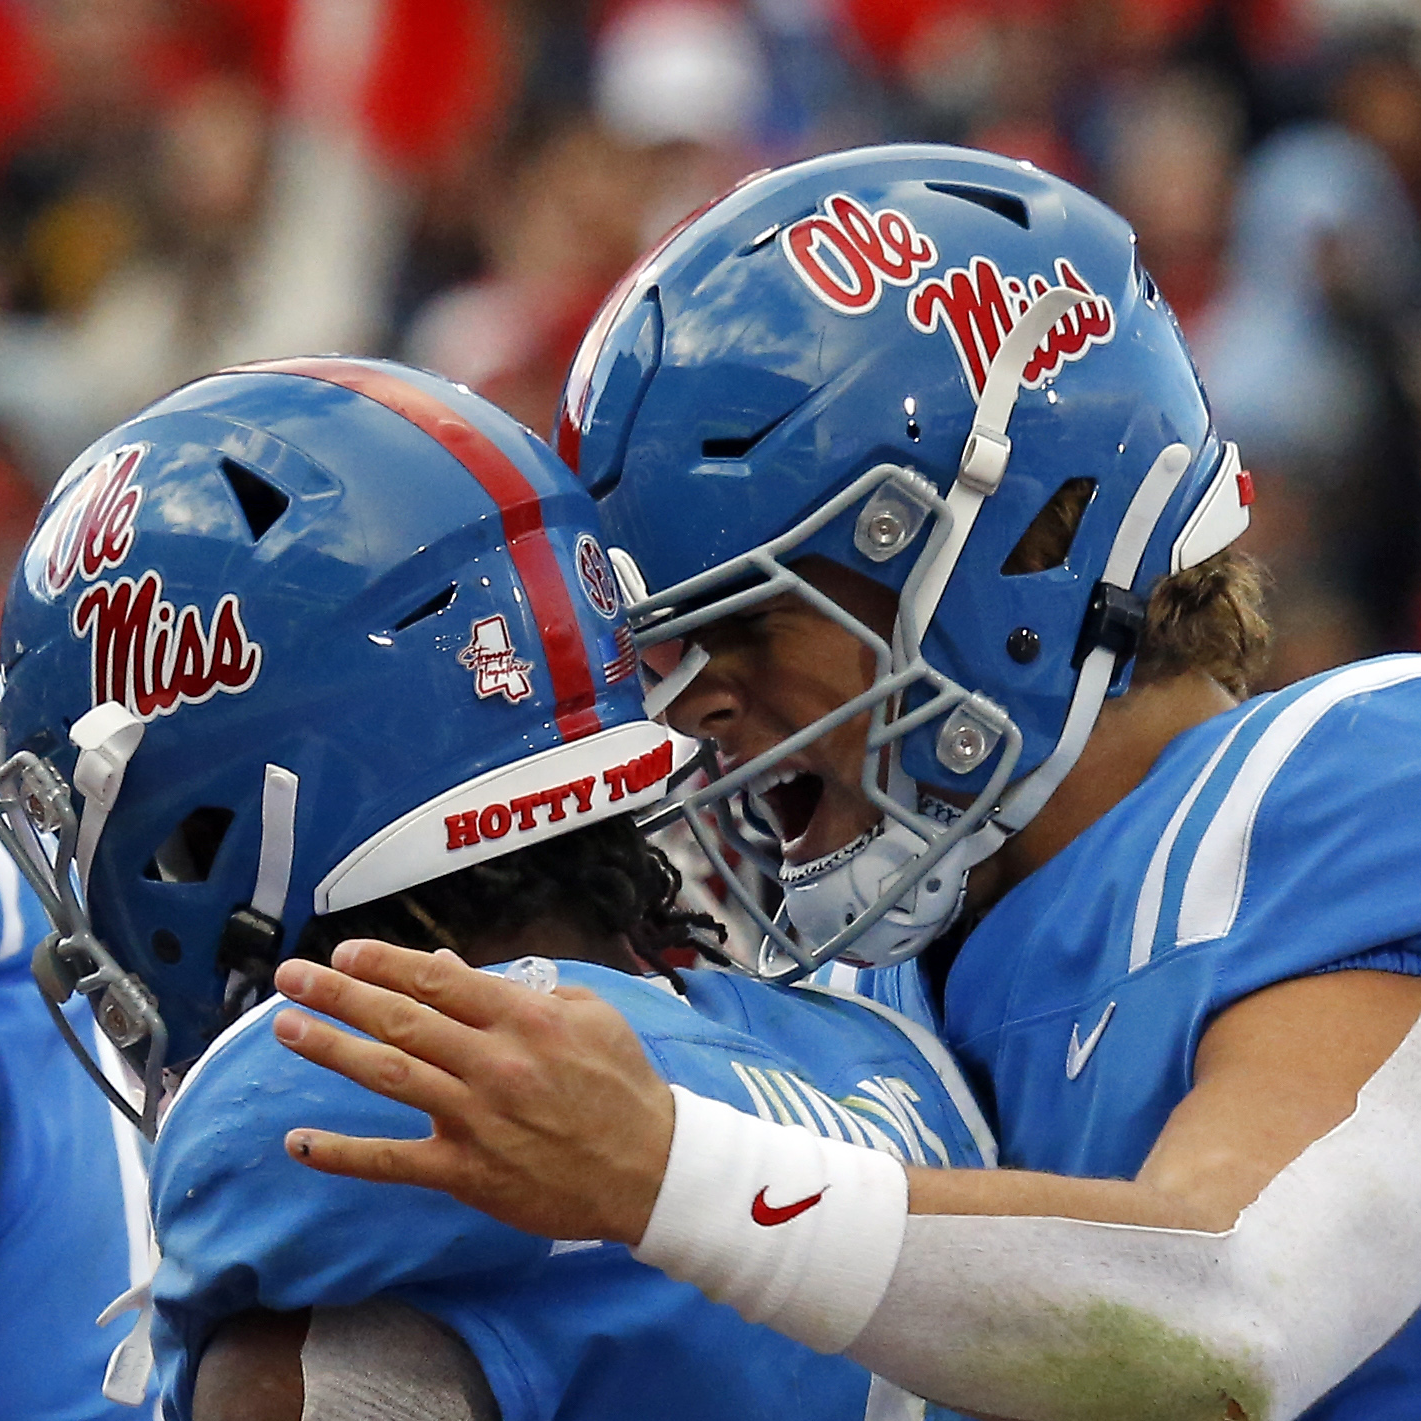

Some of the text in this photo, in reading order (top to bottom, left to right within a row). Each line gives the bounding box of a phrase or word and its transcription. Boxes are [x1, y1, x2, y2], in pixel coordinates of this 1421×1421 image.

[783, 192, 939, 316] Ole
[40, 442, 144, 598] Ole
[72, 570, 262, 723] Miss
[444, 775, 596, 850] HOTTY
